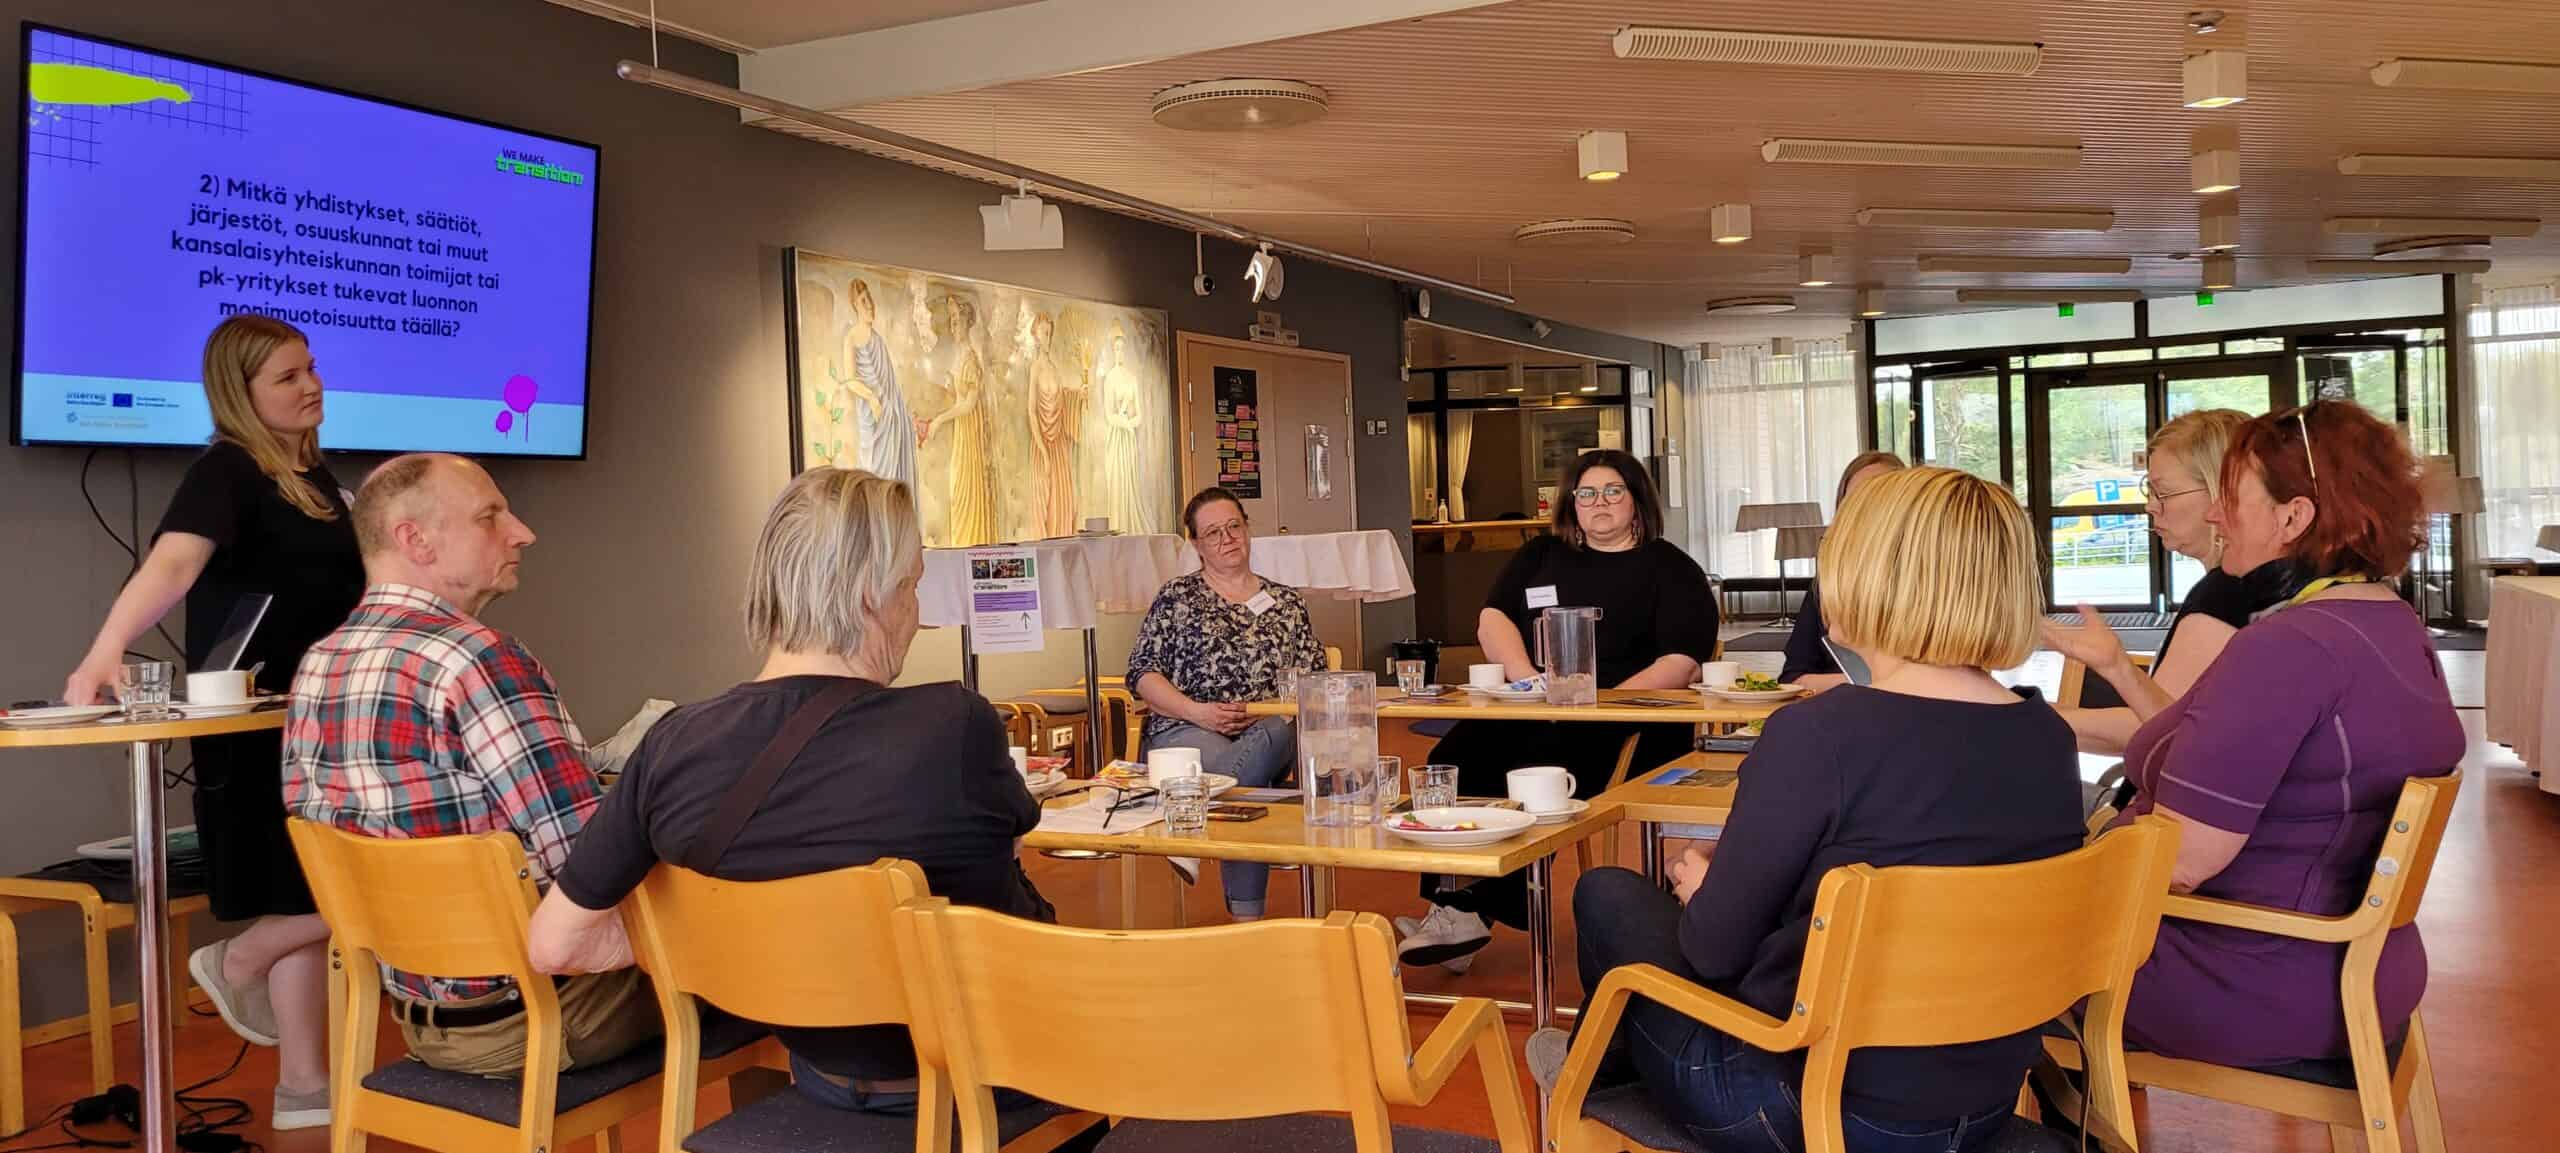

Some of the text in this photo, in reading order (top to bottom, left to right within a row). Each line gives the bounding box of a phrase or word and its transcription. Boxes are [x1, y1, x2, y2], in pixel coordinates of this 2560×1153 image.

[503, 147, 545, 166] WE MAKE
[200, 174, 482, 237] 2) Mitkä yhdistykset, säätiöt,
[188, 203, 488, 262] järjestöt, osuuskunnat tai muut
[171, 230, 499, 290] kansalaisyhteiskunnan toimijat tai
[199, 266, 478, 313] pk-yritykset tukevat luonnon
[401, 315, 460, 337] täällä?
[2100, 481, 2117, 500] P
